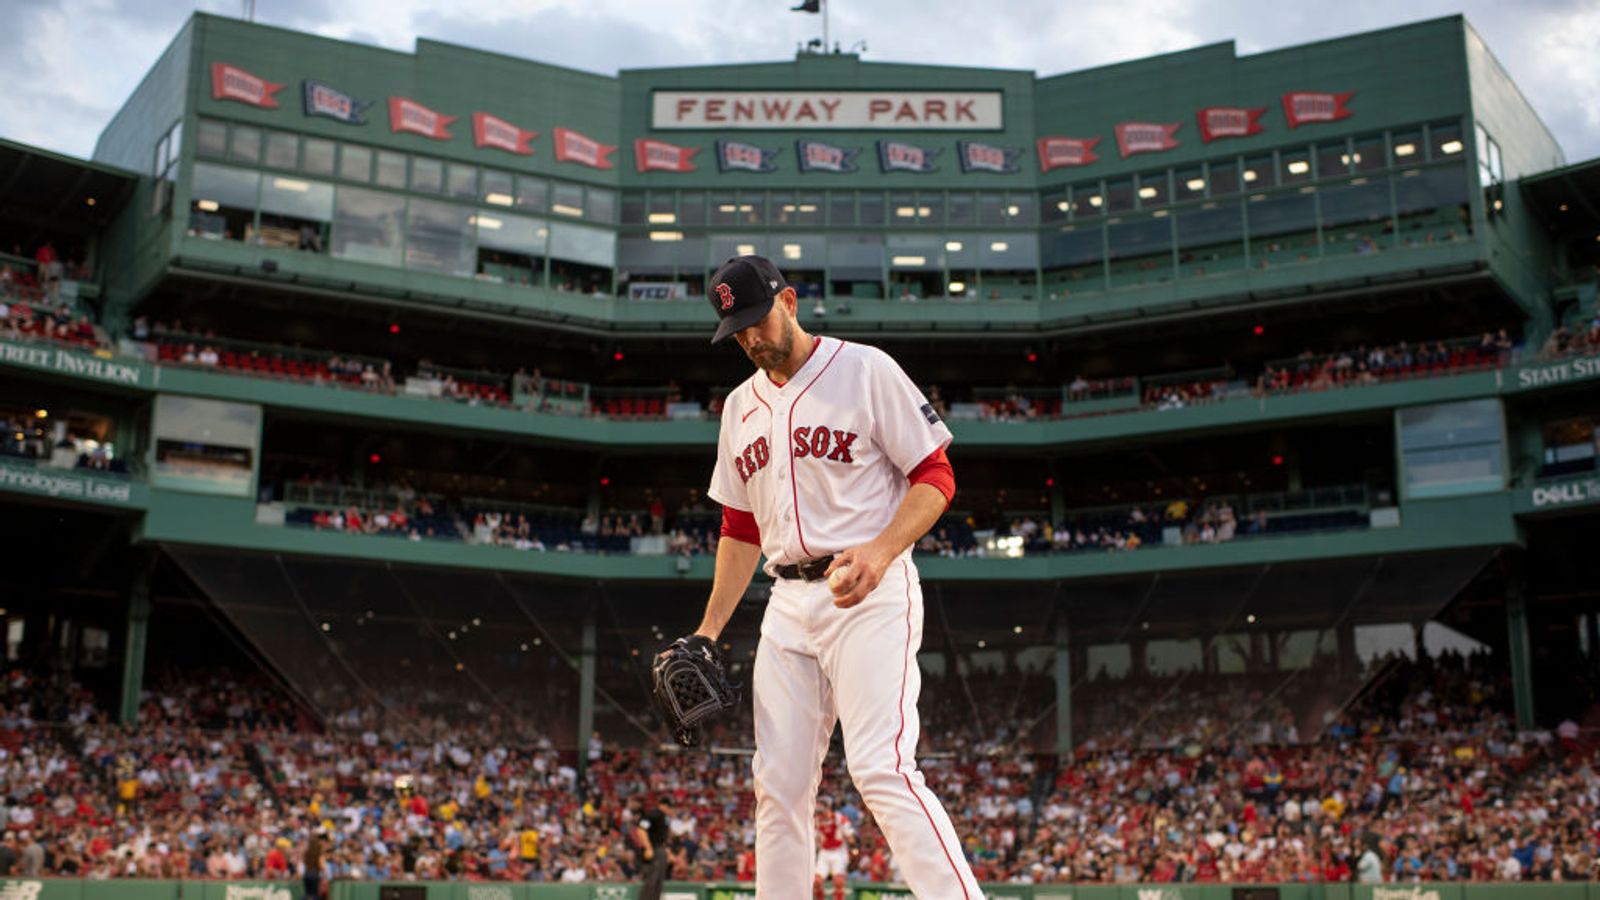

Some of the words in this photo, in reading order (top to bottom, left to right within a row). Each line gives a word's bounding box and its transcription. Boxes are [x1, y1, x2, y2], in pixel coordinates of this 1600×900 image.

[676, 98, 841, 122] FENWAY
[869, 99, 979, 122] PARK
[715, 282, 735, 310] B
[56, 351, 140, 384] PAVILION
[1519, 365, 1570, 386] STATE
[735, 436, 770, 484] RED
[793, 424, 859, 464] SOX
[87, 478, 130, 500] Level
[1533, 478, 1584, 505] DELL
